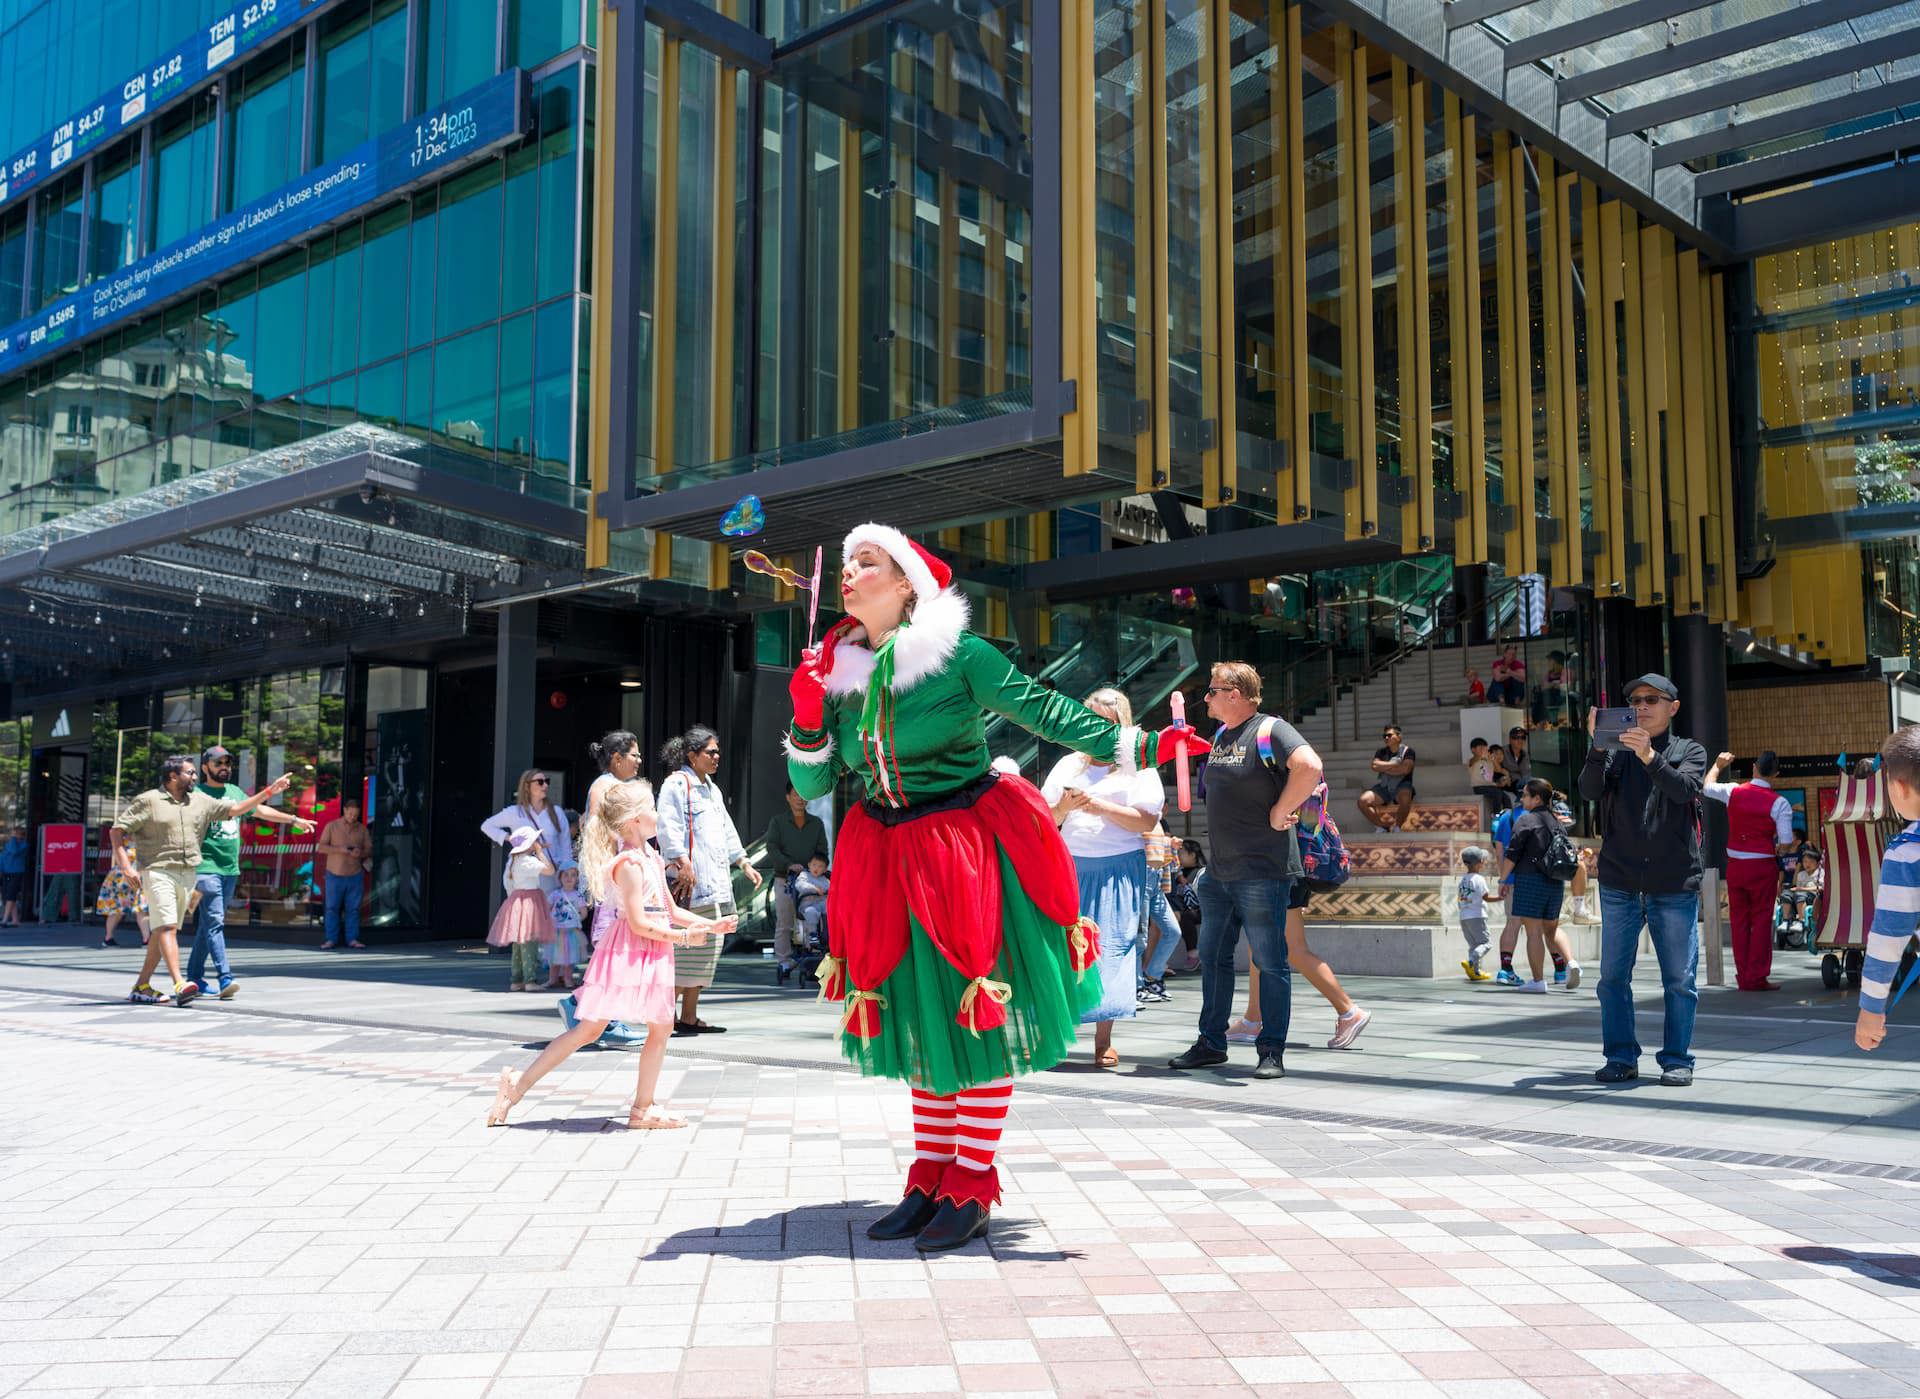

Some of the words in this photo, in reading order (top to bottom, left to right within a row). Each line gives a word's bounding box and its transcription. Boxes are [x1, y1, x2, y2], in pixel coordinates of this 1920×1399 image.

[209, 13, 235, 45] TEM
[123, 73, 146, 100] CEN
[152, 55, 182, 88] $7.82
[52, 121, 73, 148] ATM
[77, 105, 105, 135] $4.37
[411, 149, 423, 168] 17
[426, 141, 447, 160] Dec
[449, 122, 477, 149] 2023
[415, 107, 472, 147] 1:34pm
[12, 150, 37, 178] $8.42
[93, 284, 113, 304] Cook
[113, 274, 133, 295] Strait
[134, 268, 151, 283] ferry
[152, 249, 183, 275] debacle
[184, 235, 216, 260] another
[217, 226, 235, 244] sign
[236, 213, 247, 233] of
[247, 197, 285, 228] Labour's
[286, 192, 312, 208] loose
[313, 161, 360, 198] spending
[93, 304, 109, 320] Fran
[110, 286, 147, 312] O'Sullivan
[30, 325, 47, 345] EUR
[48, 304, 76, 329] 0.5695
